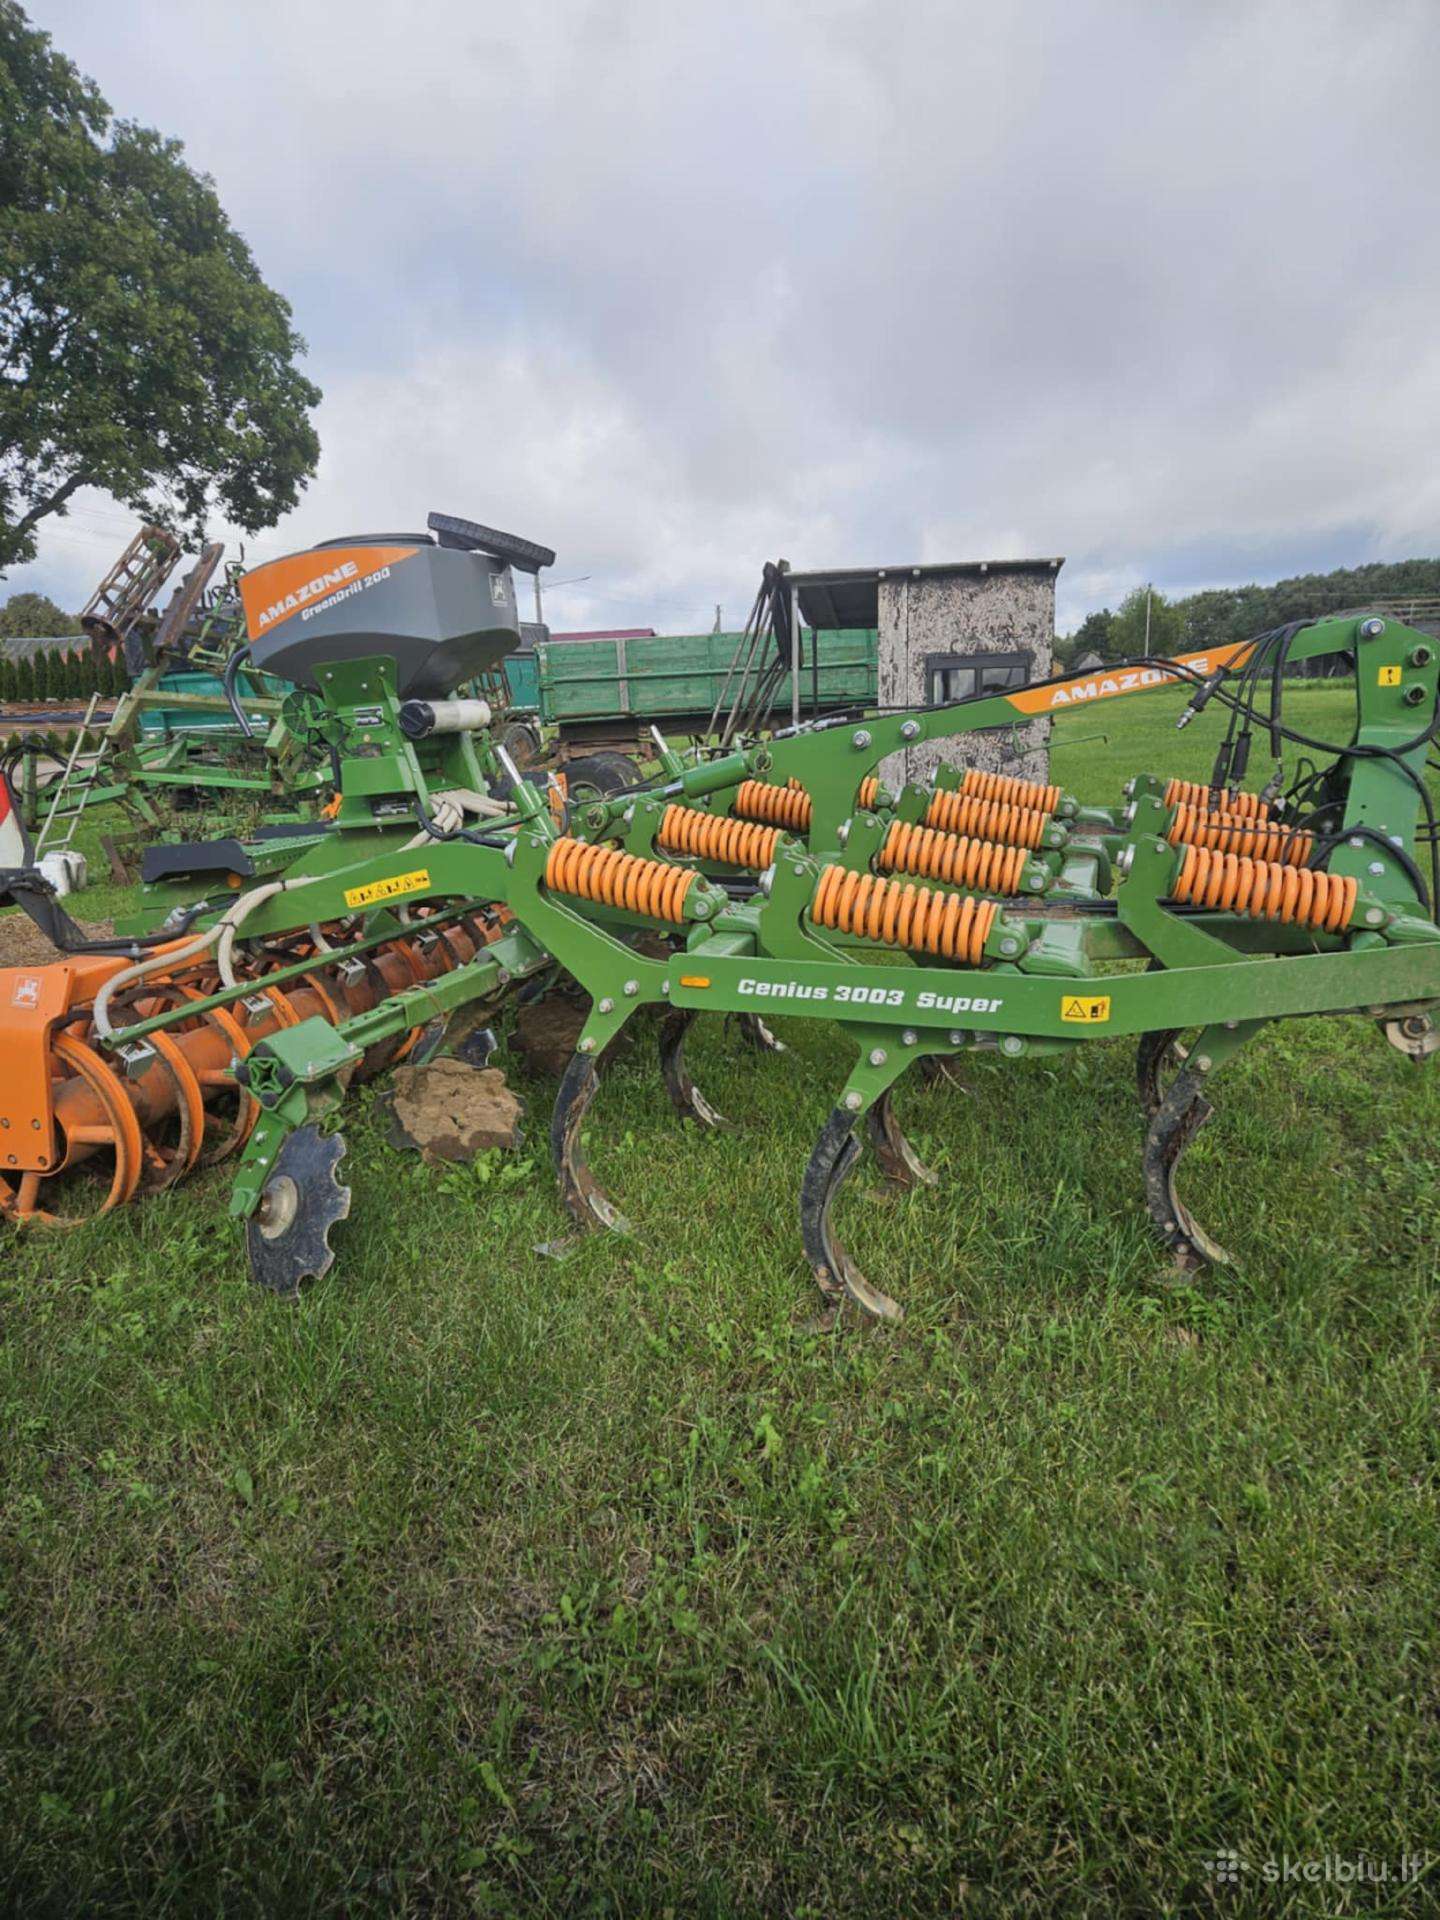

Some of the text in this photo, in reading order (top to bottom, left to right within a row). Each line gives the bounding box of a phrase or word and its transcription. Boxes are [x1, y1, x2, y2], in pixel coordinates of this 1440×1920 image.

[258, 561, 359, 627] AMAZONE
[301, 566, 391, 621] GreenDrill 200
[738, 979, 1003, 1014] Cenius 3003 Super
